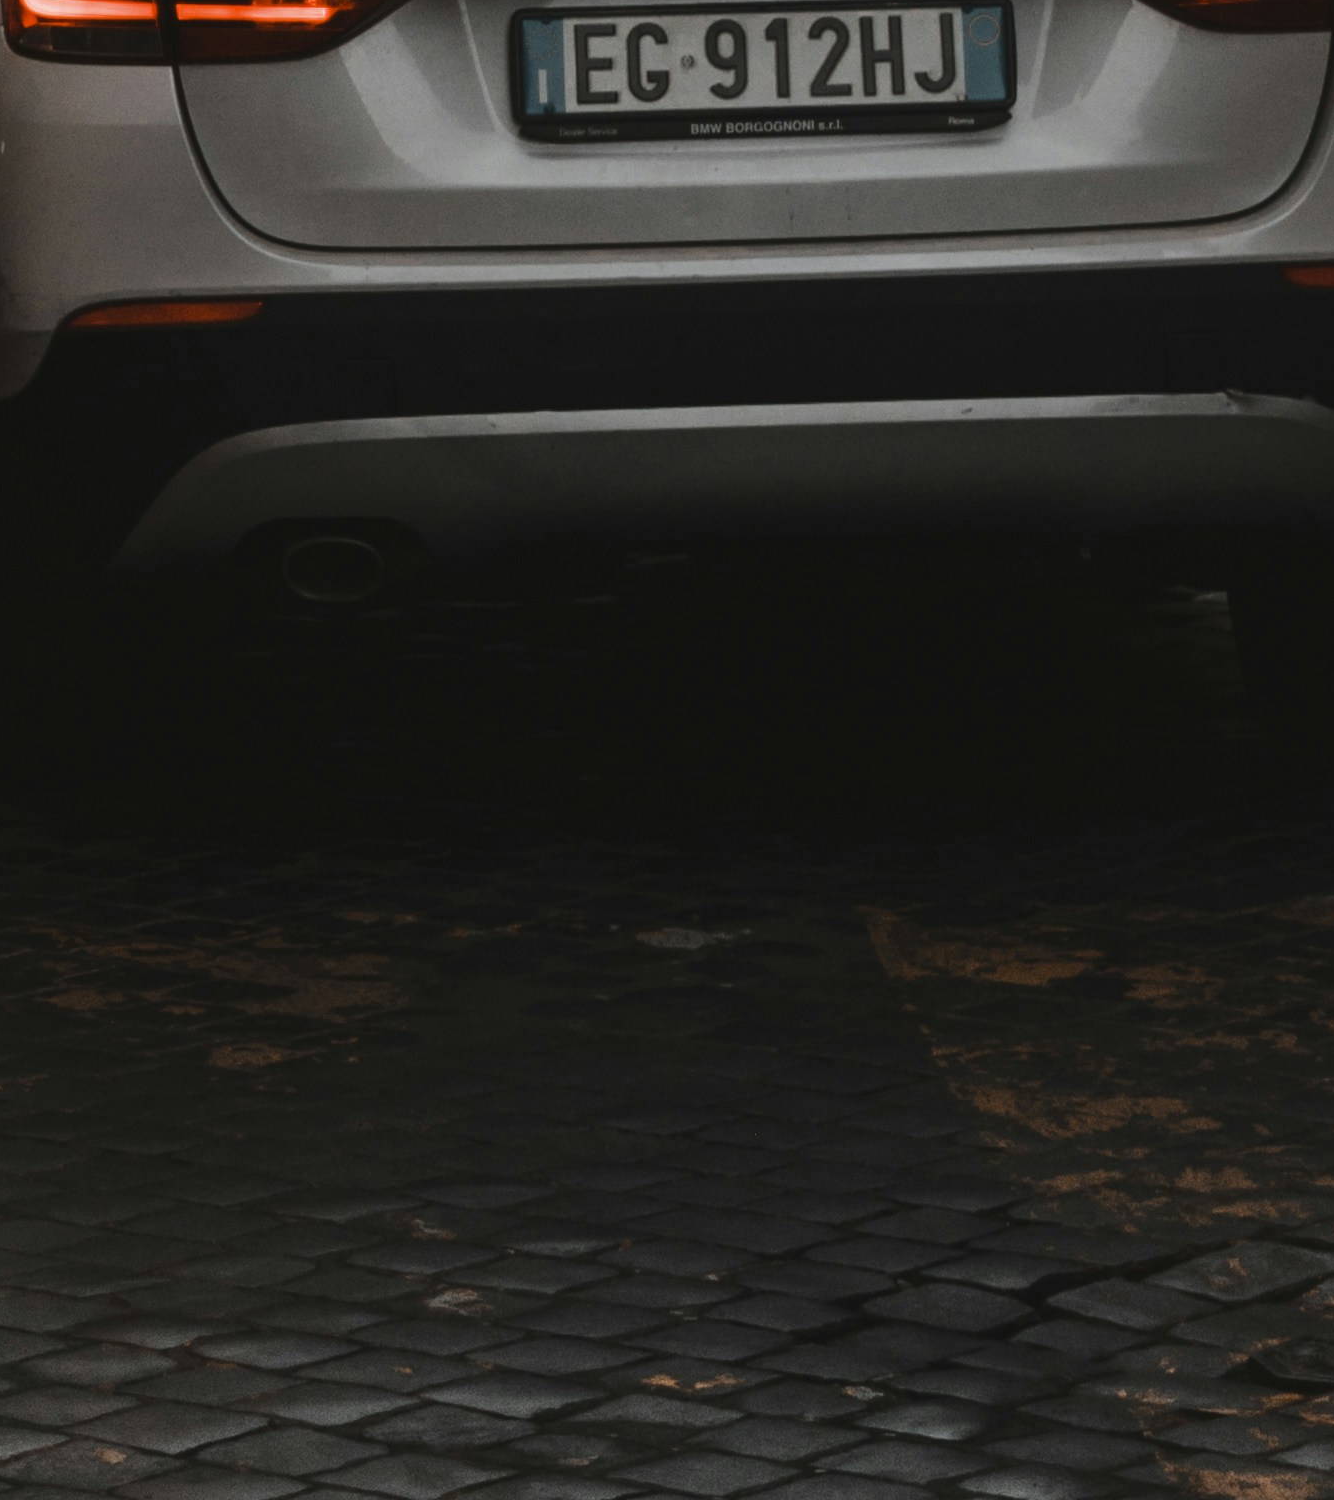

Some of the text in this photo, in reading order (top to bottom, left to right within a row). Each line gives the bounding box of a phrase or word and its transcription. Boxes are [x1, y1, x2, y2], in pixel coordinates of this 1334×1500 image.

[573, 12, 957, 105] EG 912HJ
[690, 118, 844, 135] BMW BORGOGNONI s.r.l.
[947, 115, 976, 126] Roma
[587, 126, 618, 136] Service
